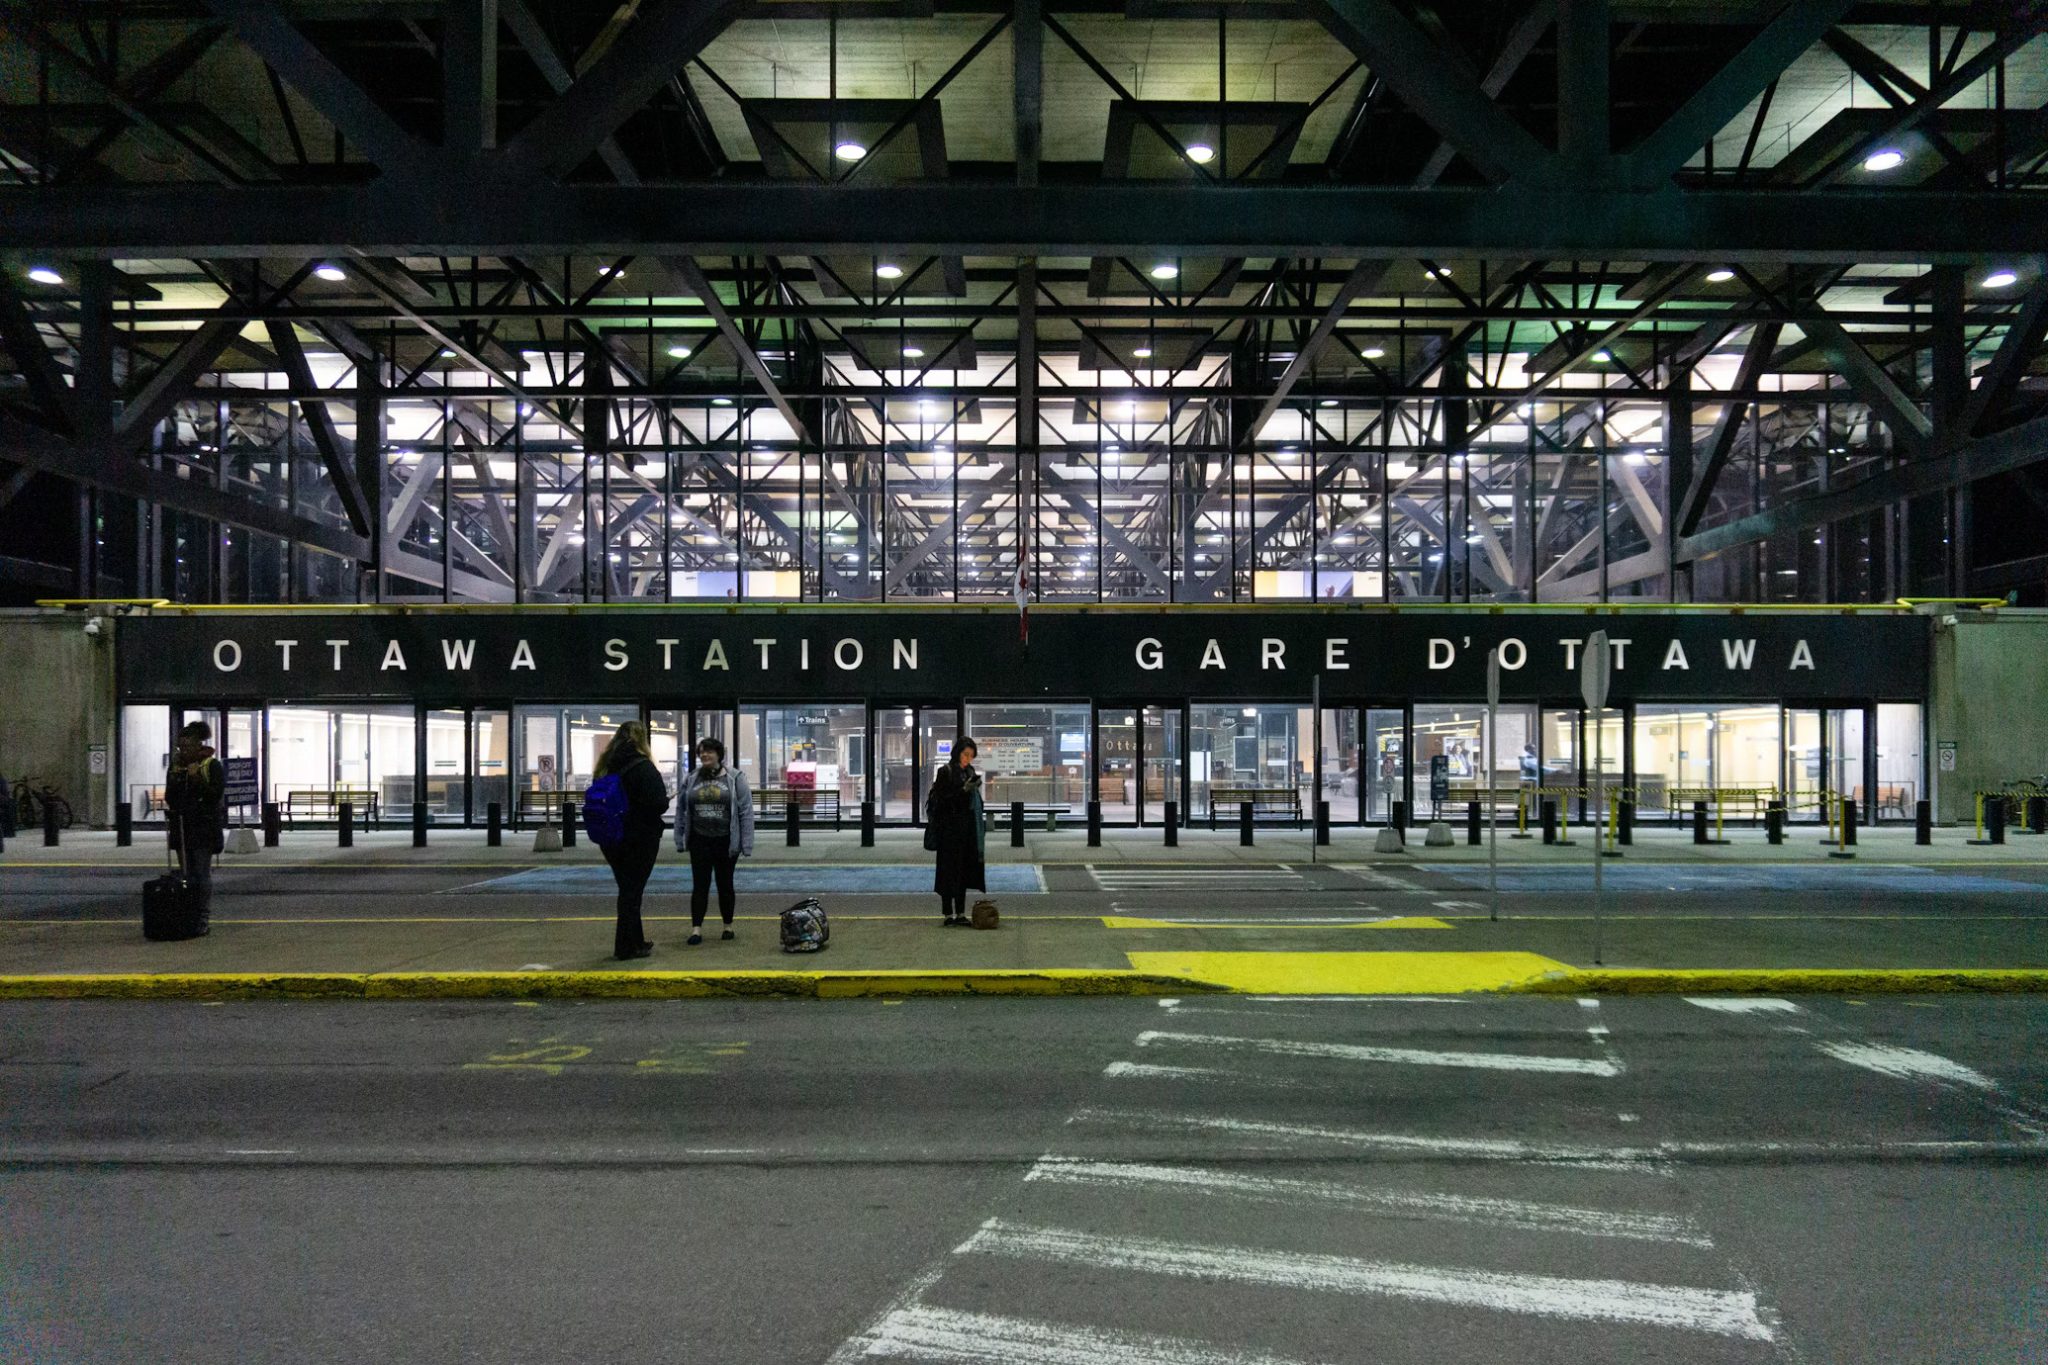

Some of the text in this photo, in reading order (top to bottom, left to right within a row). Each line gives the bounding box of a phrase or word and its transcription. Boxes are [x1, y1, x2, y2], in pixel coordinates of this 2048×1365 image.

[213, 637, 919, 672] OTTAWA STATION
[1135, 637, 1816, 671] GARE D'OTTAWA
[805, 716, 826, 724] Trains
